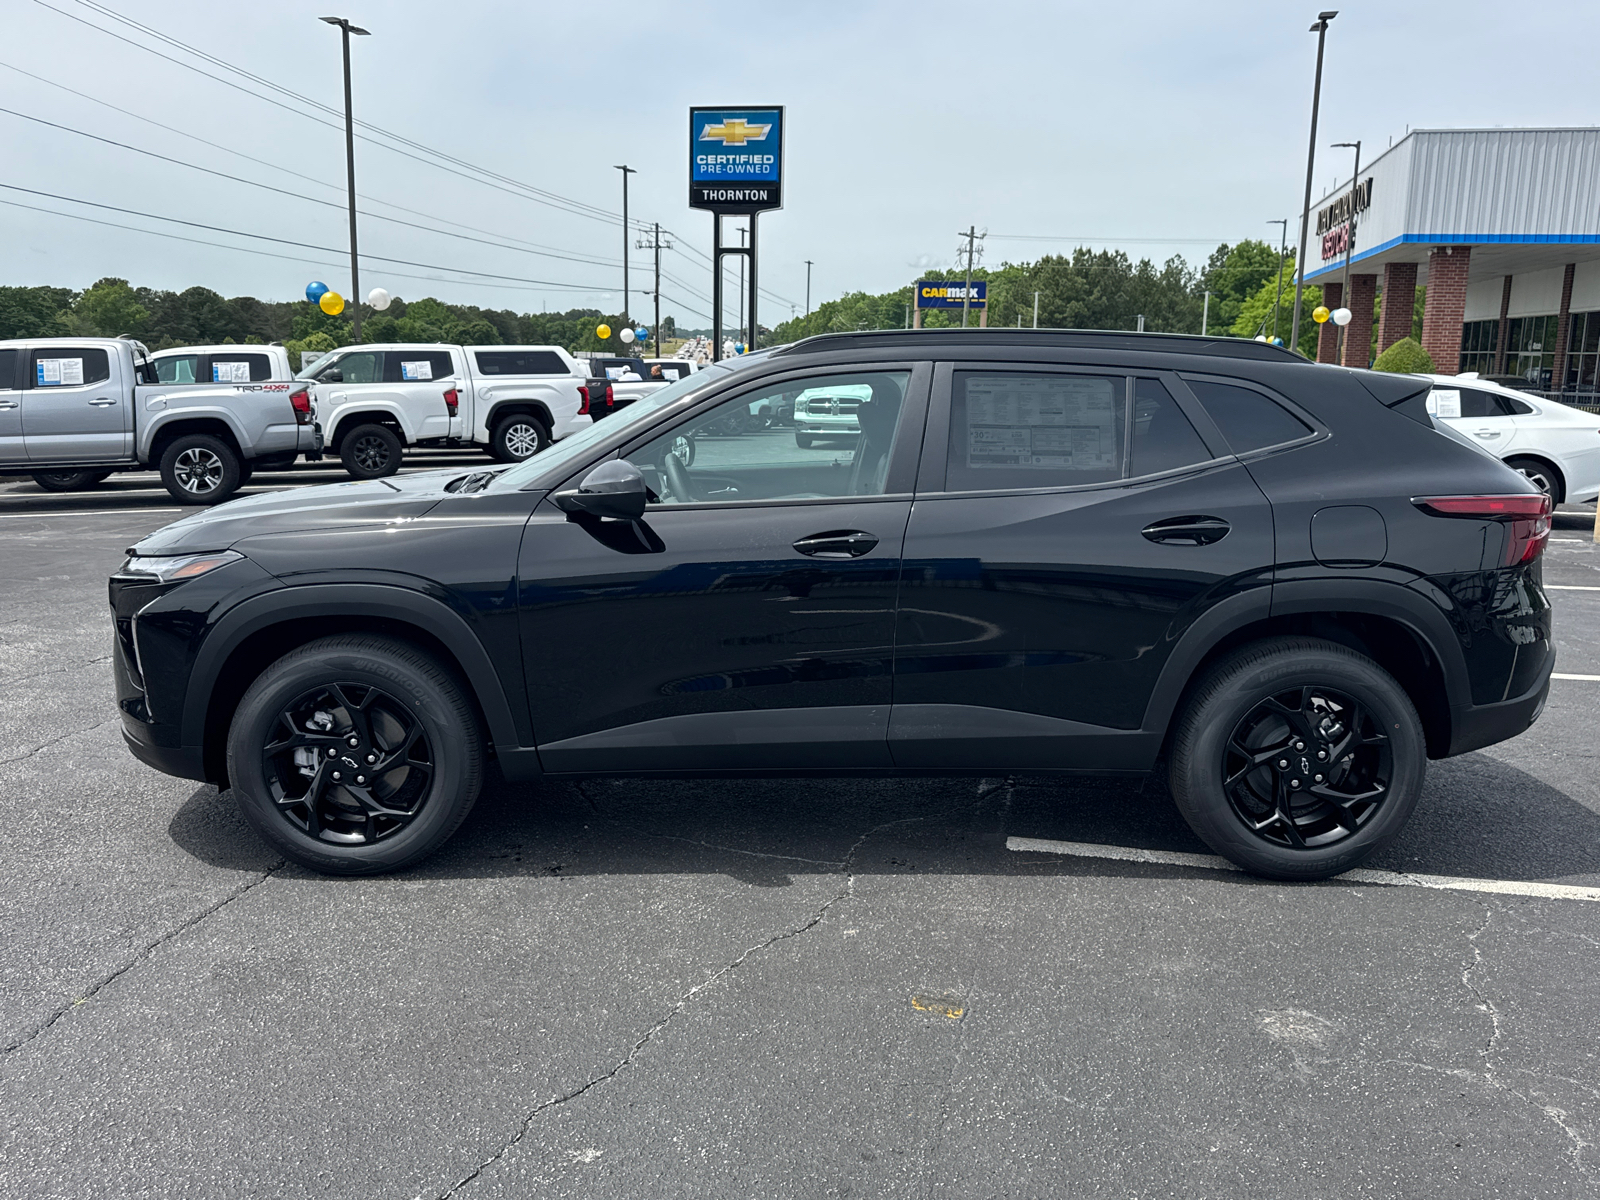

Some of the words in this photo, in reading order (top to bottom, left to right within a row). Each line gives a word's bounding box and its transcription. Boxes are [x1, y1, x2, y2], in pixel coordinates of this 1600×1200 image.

[696, 155, 774, 164] CERTIFIED
[700, 165, 770, 173] PRE-OWNED
[702, 190, 768, 201] THORNTON
